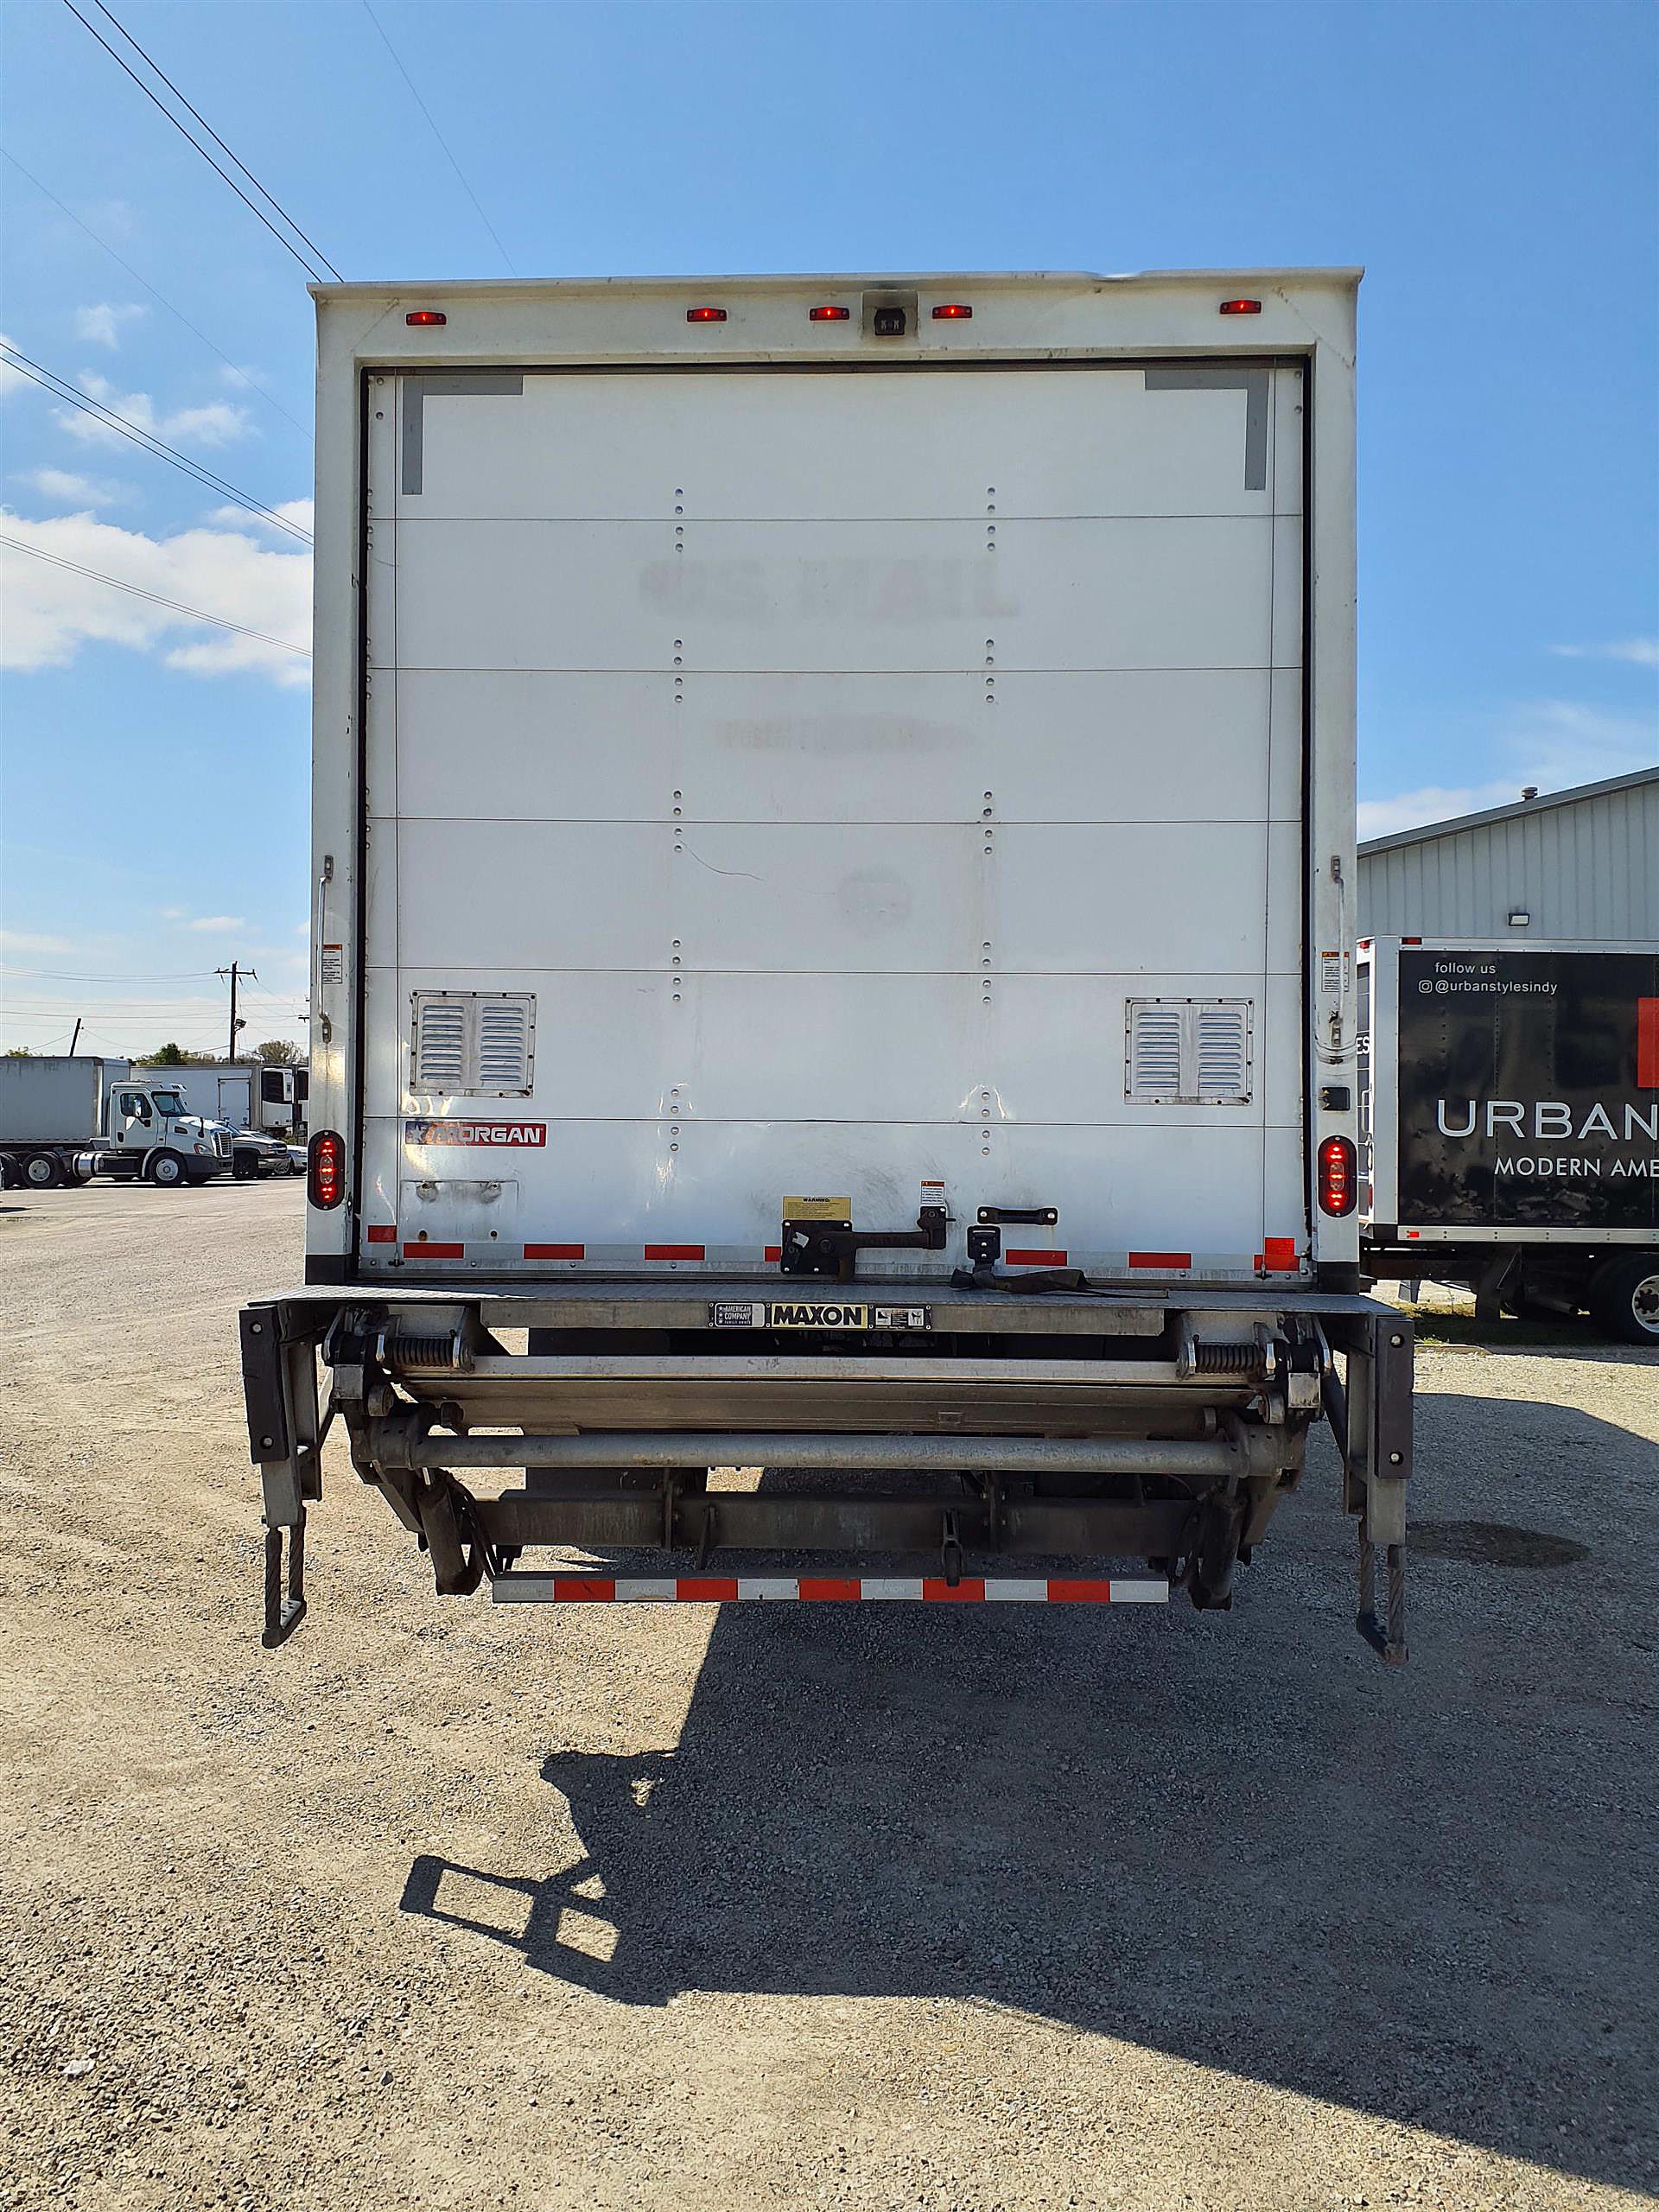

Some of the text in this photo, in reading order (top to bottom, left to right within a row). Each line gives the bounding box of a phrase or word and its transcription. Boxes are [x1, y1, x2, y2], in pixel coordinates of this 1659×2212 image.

[1435, 962, 1497, 974] follow us
[1435, 980, 1558, 995] @urbanstylesindy
[1438, 1099, 1658, 1141] URBAN
[1494, 1156, 1659, 1178] MODERN AME
[773, 1306, 862, 1326] MAXON
